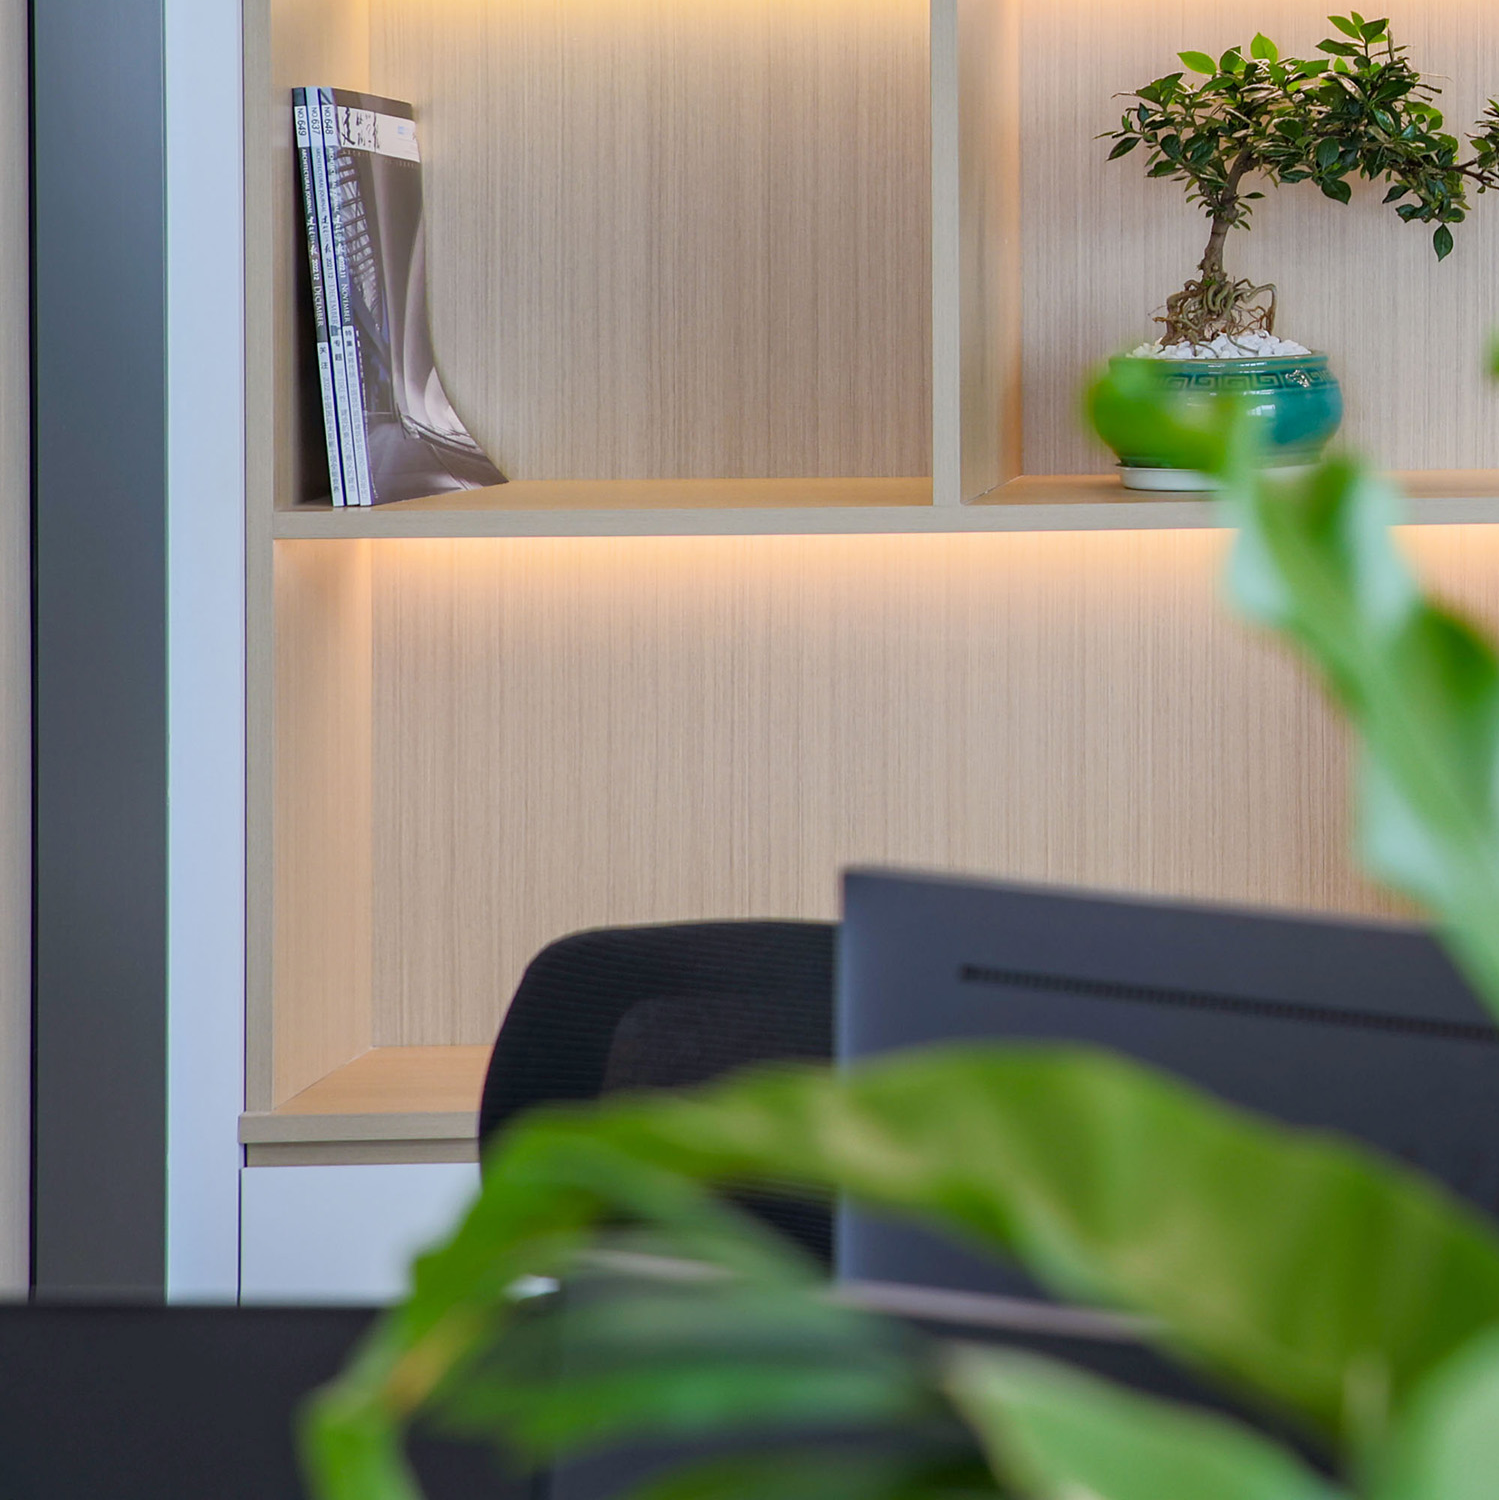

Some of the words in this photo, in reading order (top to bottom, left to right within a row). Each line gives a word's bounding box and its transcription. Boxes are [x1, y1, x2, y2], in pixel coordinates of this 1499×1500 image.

[301, 149, 311, 190] ARCHITECTURAL
[314, 147, 324, 189] ARCHITECTURAL
[319, 190, 327, 212] JOURNAL
[304, 190, 313, 214] JOURNAL
[313, 286, 325, 327] DECEMBER
[340, 283, 352, 322] NOVEMBER
